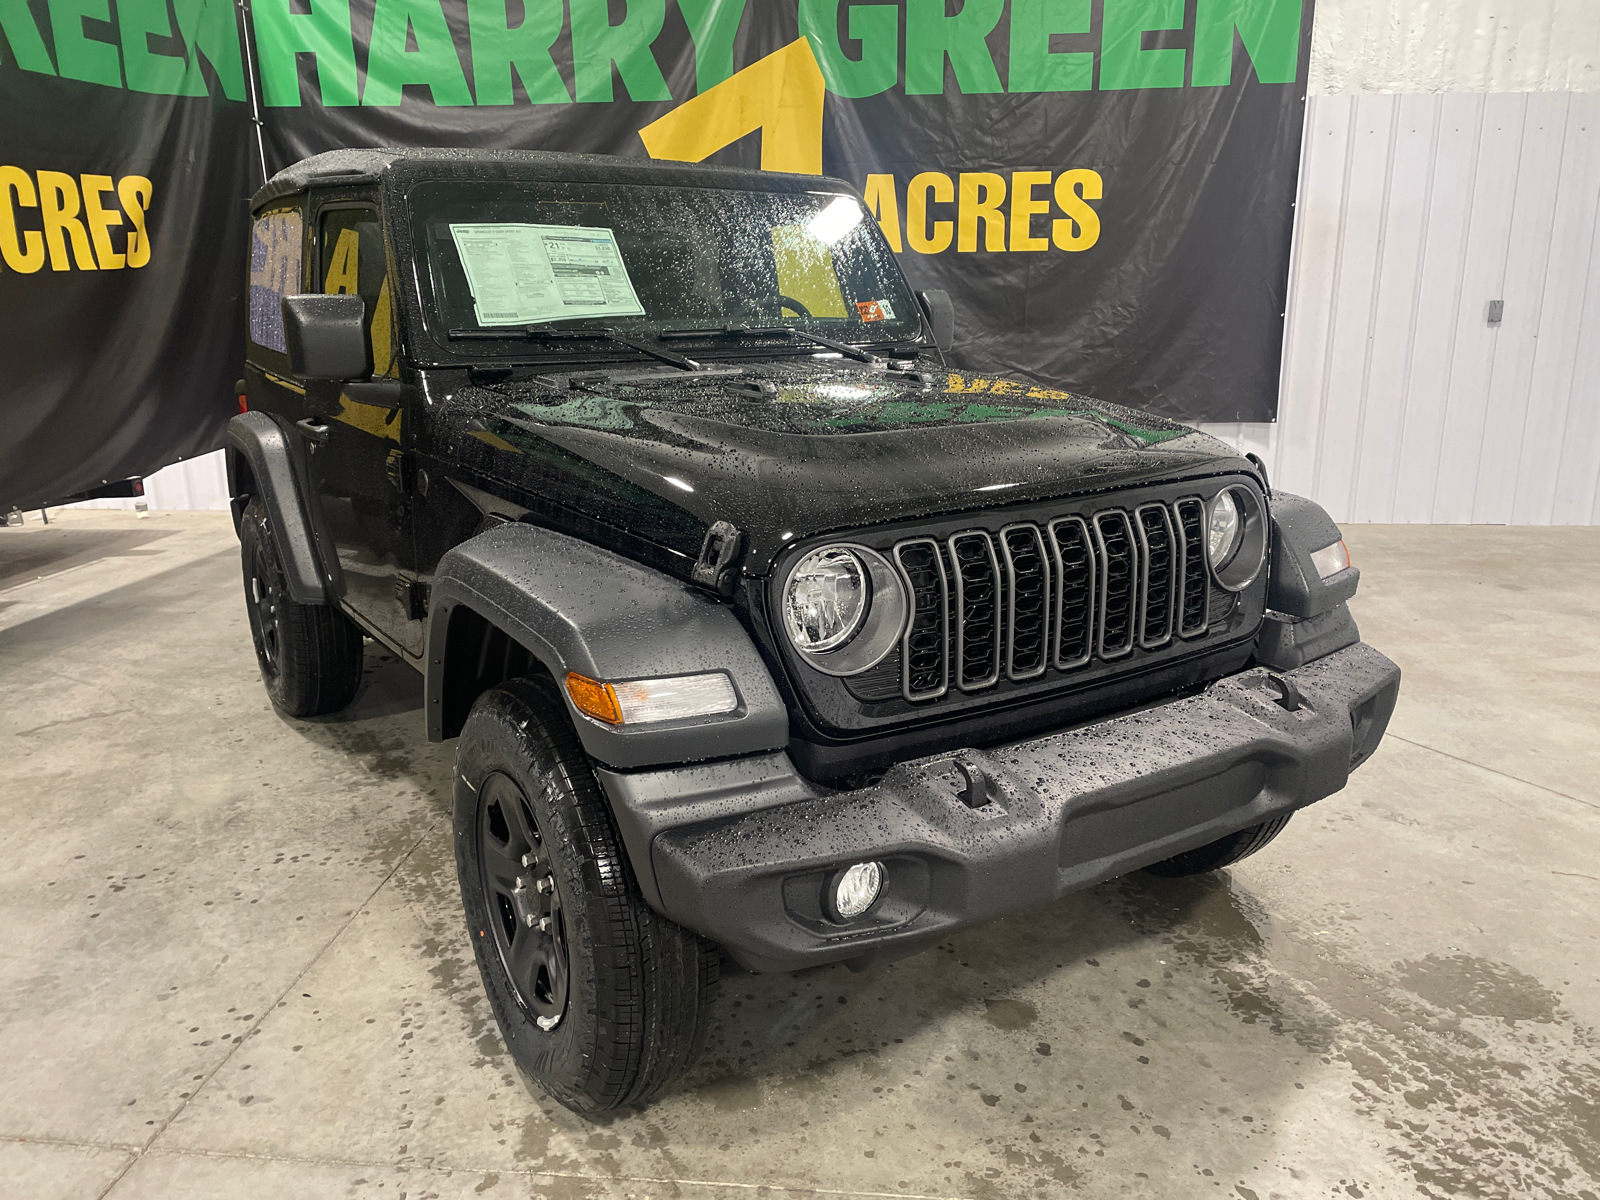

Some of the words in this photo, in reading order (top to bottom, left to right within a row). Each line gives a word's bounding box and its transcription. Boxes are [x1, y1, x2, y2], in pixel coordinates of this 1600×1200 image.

[253, 0, 746, 107] HARRY
[800, 0, 1302, 98] GREEN
[0, 165, 152, 273] CRES
[864, 169, 1103, 254] ACRES
